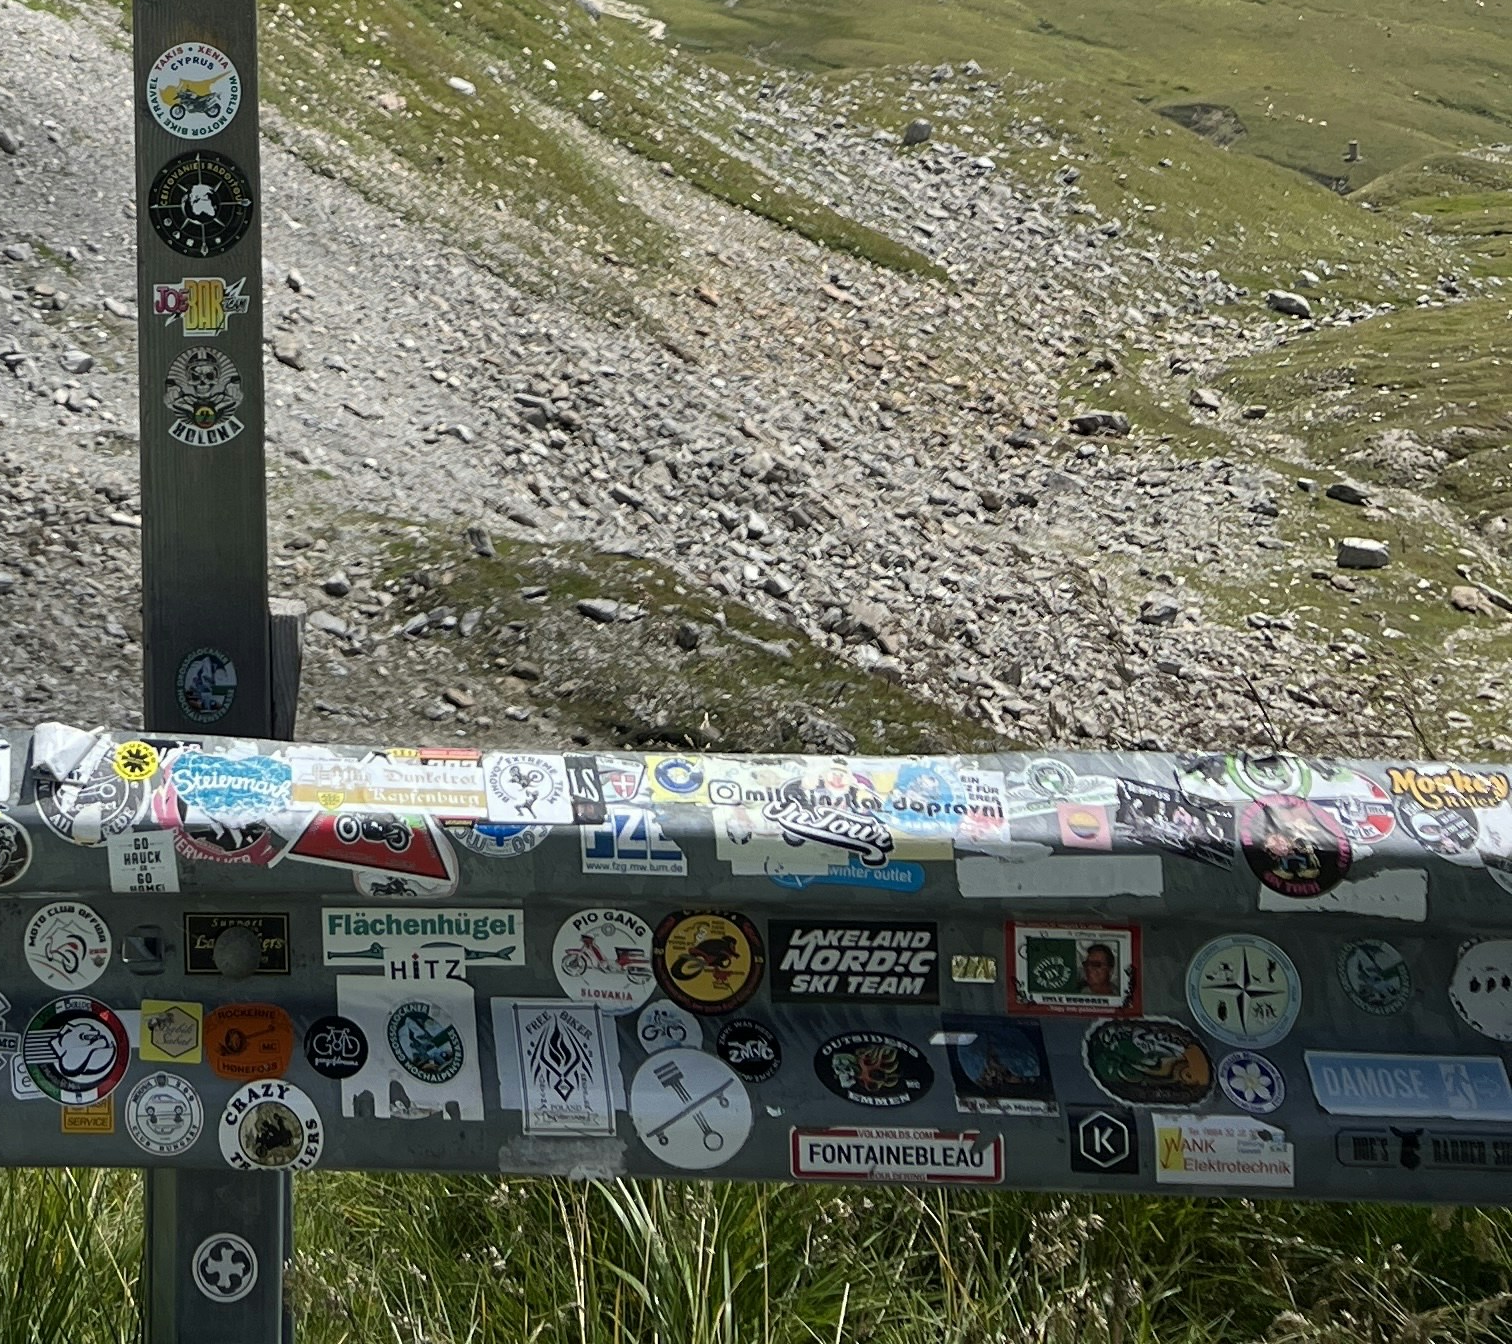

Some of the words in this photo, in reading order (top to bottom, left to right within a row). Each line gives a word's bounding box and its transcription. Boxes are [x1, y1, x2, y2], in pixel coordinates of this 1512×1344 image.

[155, 46, 185, 72] TAKIS
[197, 45, 230, 70] XENIA
[170, 57, 214, 72] CYPRUS
[148, 76, 169, 121] TRAVEL
[226, 75, 239, 115] WORLD
[163, 116, 188, 136] BIKE
[191, 115, 228, 136] MOTOR
[156, 286, 188, 313] JOE
[185, 279, 225, 331] BAR
[172, 768, 292, 802] Steiermark
[133, 838, 149, 850] GO
[124, 851, 162, 866] HAUCK
[137, 872, 153, 884] GO
[874, 866, 913, 883] outlet
[28, 917, 47, 948] MOTO
[47, 904, 76, 918] CLUB
[328, 912, 516, 940] Flächenhügel
[573, 913, 599, 931] PIO
[603, 911, 646, 937] GANG
[789, 928, 932, 949] LAKELAND
[581, 988, 633, 1001] SLOVAKIA
[790, 975, 839, 994] SKI
[847, 976, 926, 996] TEAM
[524, 1011, 552, 1035] FREE
[559, 1010, 593, 1040] BIKER
[822, 1033, 919, 1058] OUTSIDERS
[1322, 1066, 1430, 1100] DAMOSE
[225, 1082, 290, 1126] CRAZY
[848, 1090, 911, 1106] EMMEN
[67, 1116, 109, 1127] SERVICE
[159, 1125, 199, 1152] HUNGARY
[808, 1142, 985, 1169] FONTAINEBLEAU
[1184, 1157, 1291, 1175] Elektrotechnik
